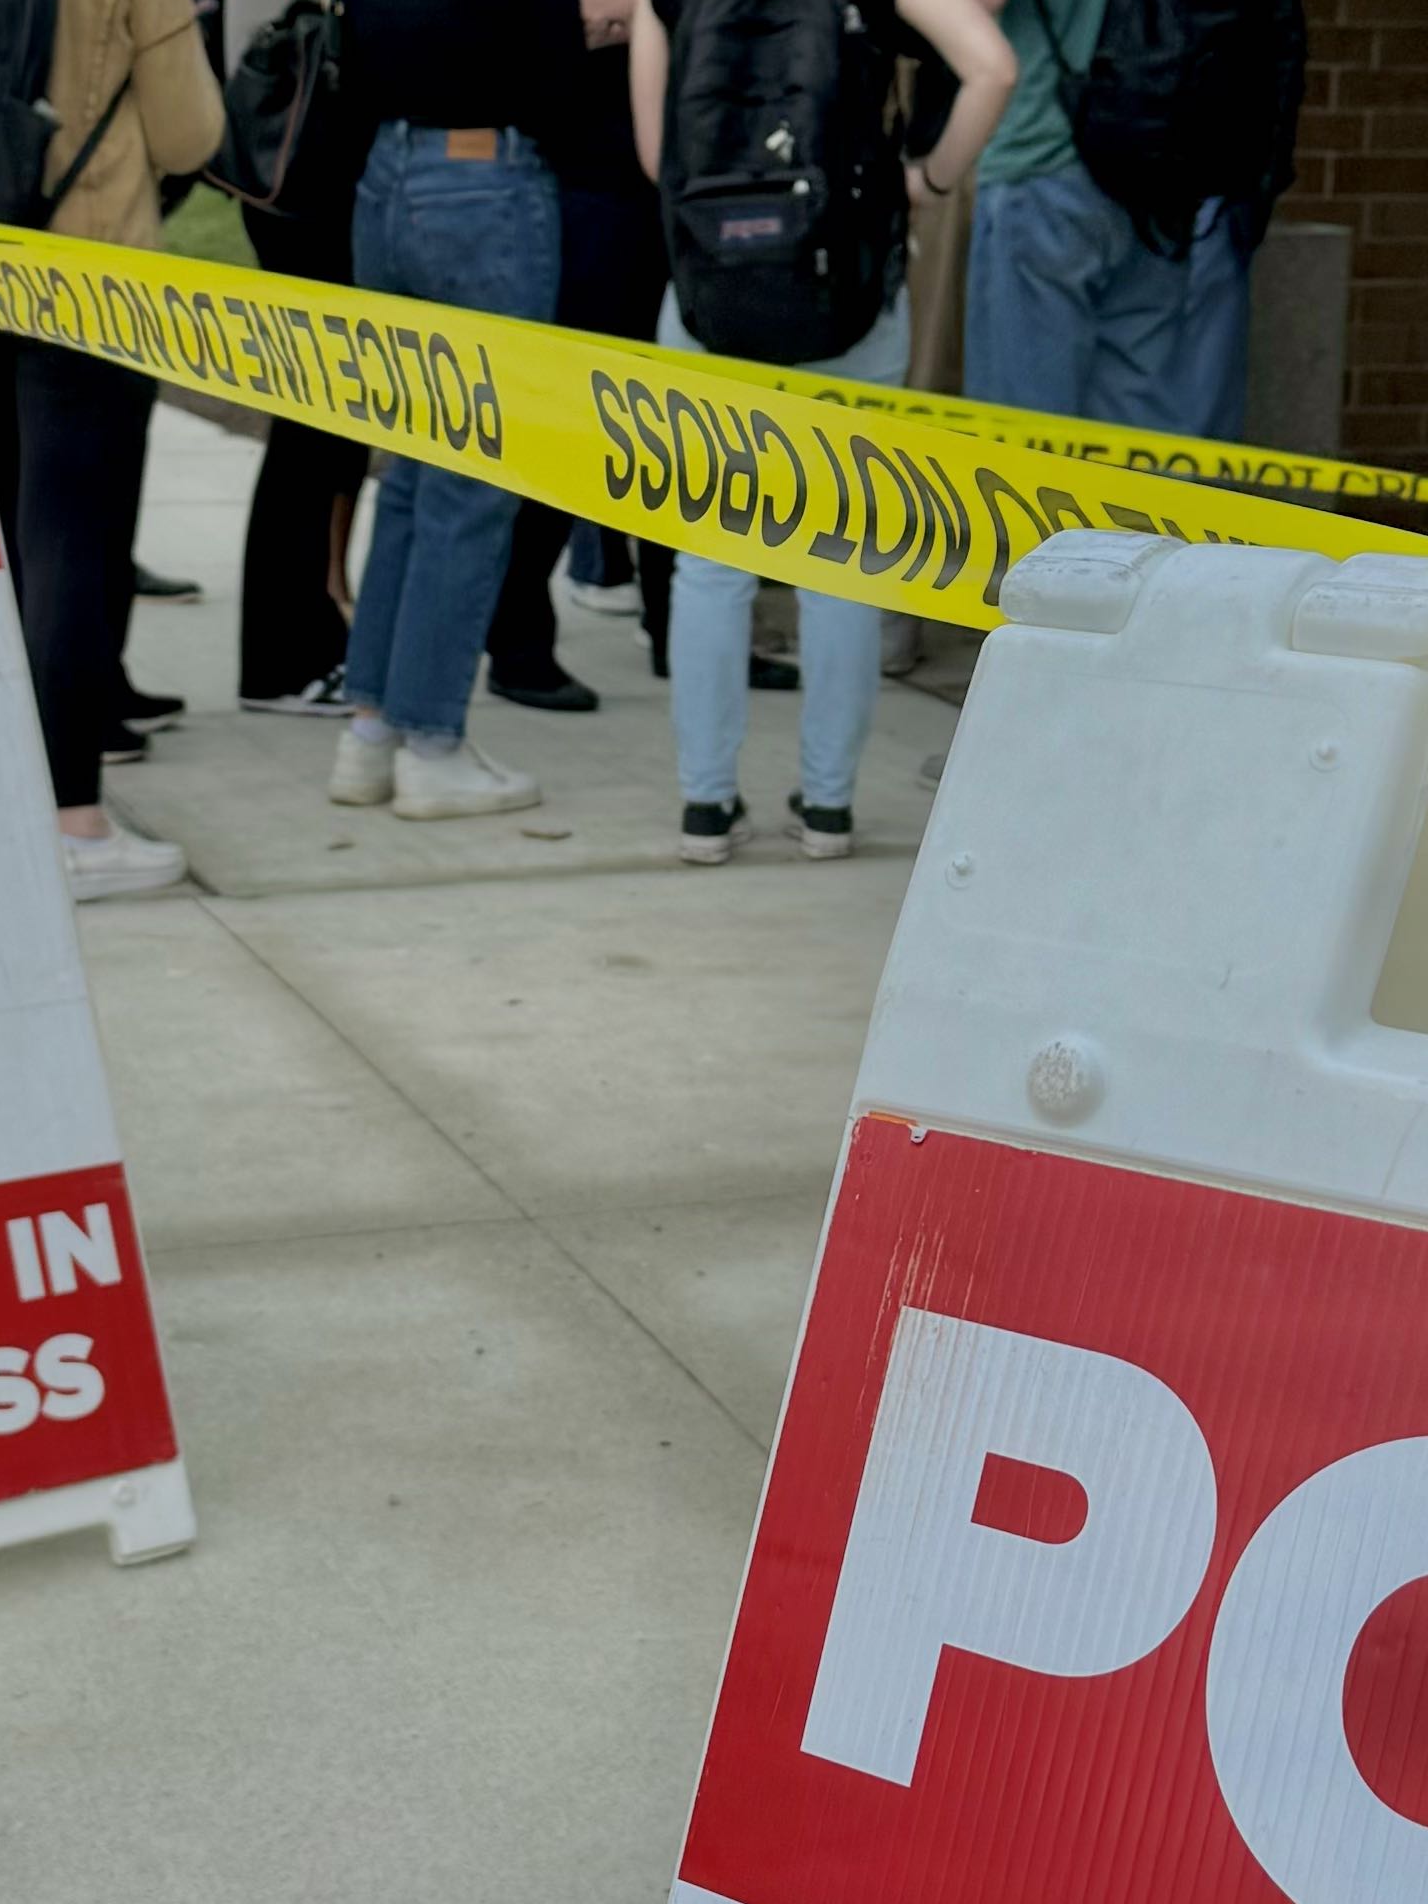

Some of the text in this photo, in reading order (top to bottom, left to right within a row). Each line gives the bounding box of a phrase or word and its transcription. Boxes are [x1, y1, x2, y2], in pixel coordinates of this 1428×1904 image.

[82, 272, 177, 372] NOT
[163, 284, 240, 388] DO
[223, 296, 337, 412] LINE
[323, 314, 503, 460] POLICE
[590, 369, 808, 548] CROSS
[807, 426, 972, 591] NOT
[6, 1203, 122, 1304] IN
